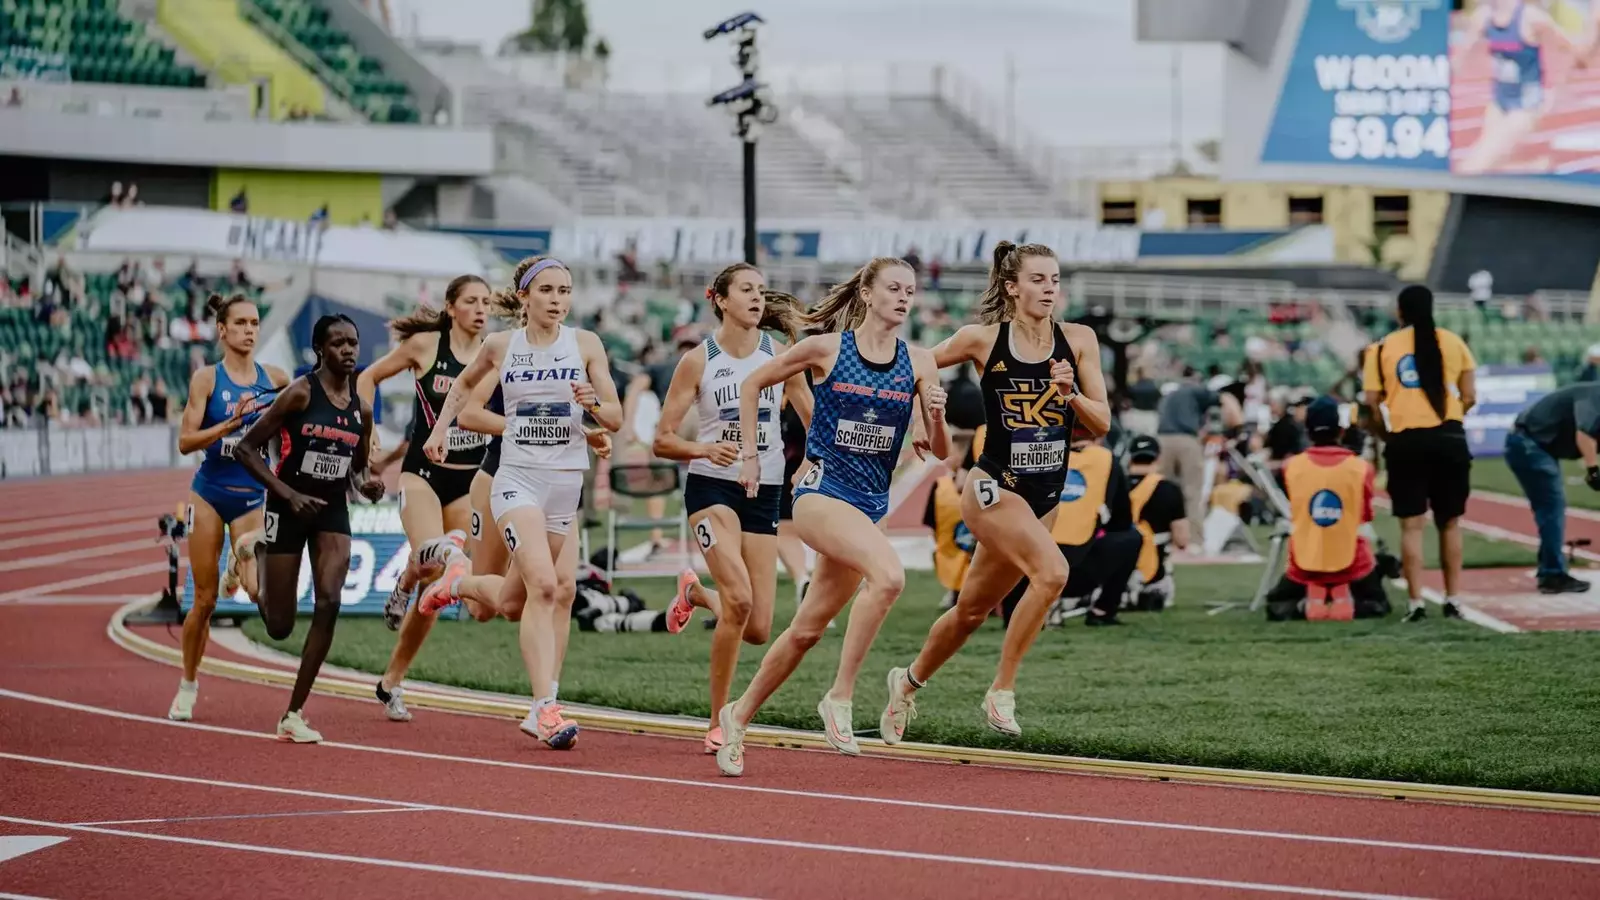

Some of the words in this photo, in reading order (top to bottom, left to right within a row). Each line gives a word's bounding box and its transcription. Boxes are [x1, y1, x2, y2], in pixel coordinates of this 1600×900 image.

[1329, 116, 1449, 159] 59.94
[505, 368, 580, 384] K-STATE
[714, 383, 775, 407] VILLVA
[832, 382, 874, 397] BOISE
[529, 417, 559, 425] KASSIDY
[854, 423, 883, 435] KRISTIE
[516, 425, 570, 439] JOHNSON
[836, 430, 893, 449] SCHOFFIELD
[1028, 443, 1053, 452] SARAH
[1012, 450, 1064, 466] HENDRICK
[313, 462, 340, 476] EWOI
[979, 480, 994, 506] 5
[265, 515, 275, 539] 2
[472, 512, 480, 536] 9
[504, 527, 516, 552] 8
[697, 524, 711, 548] 3
